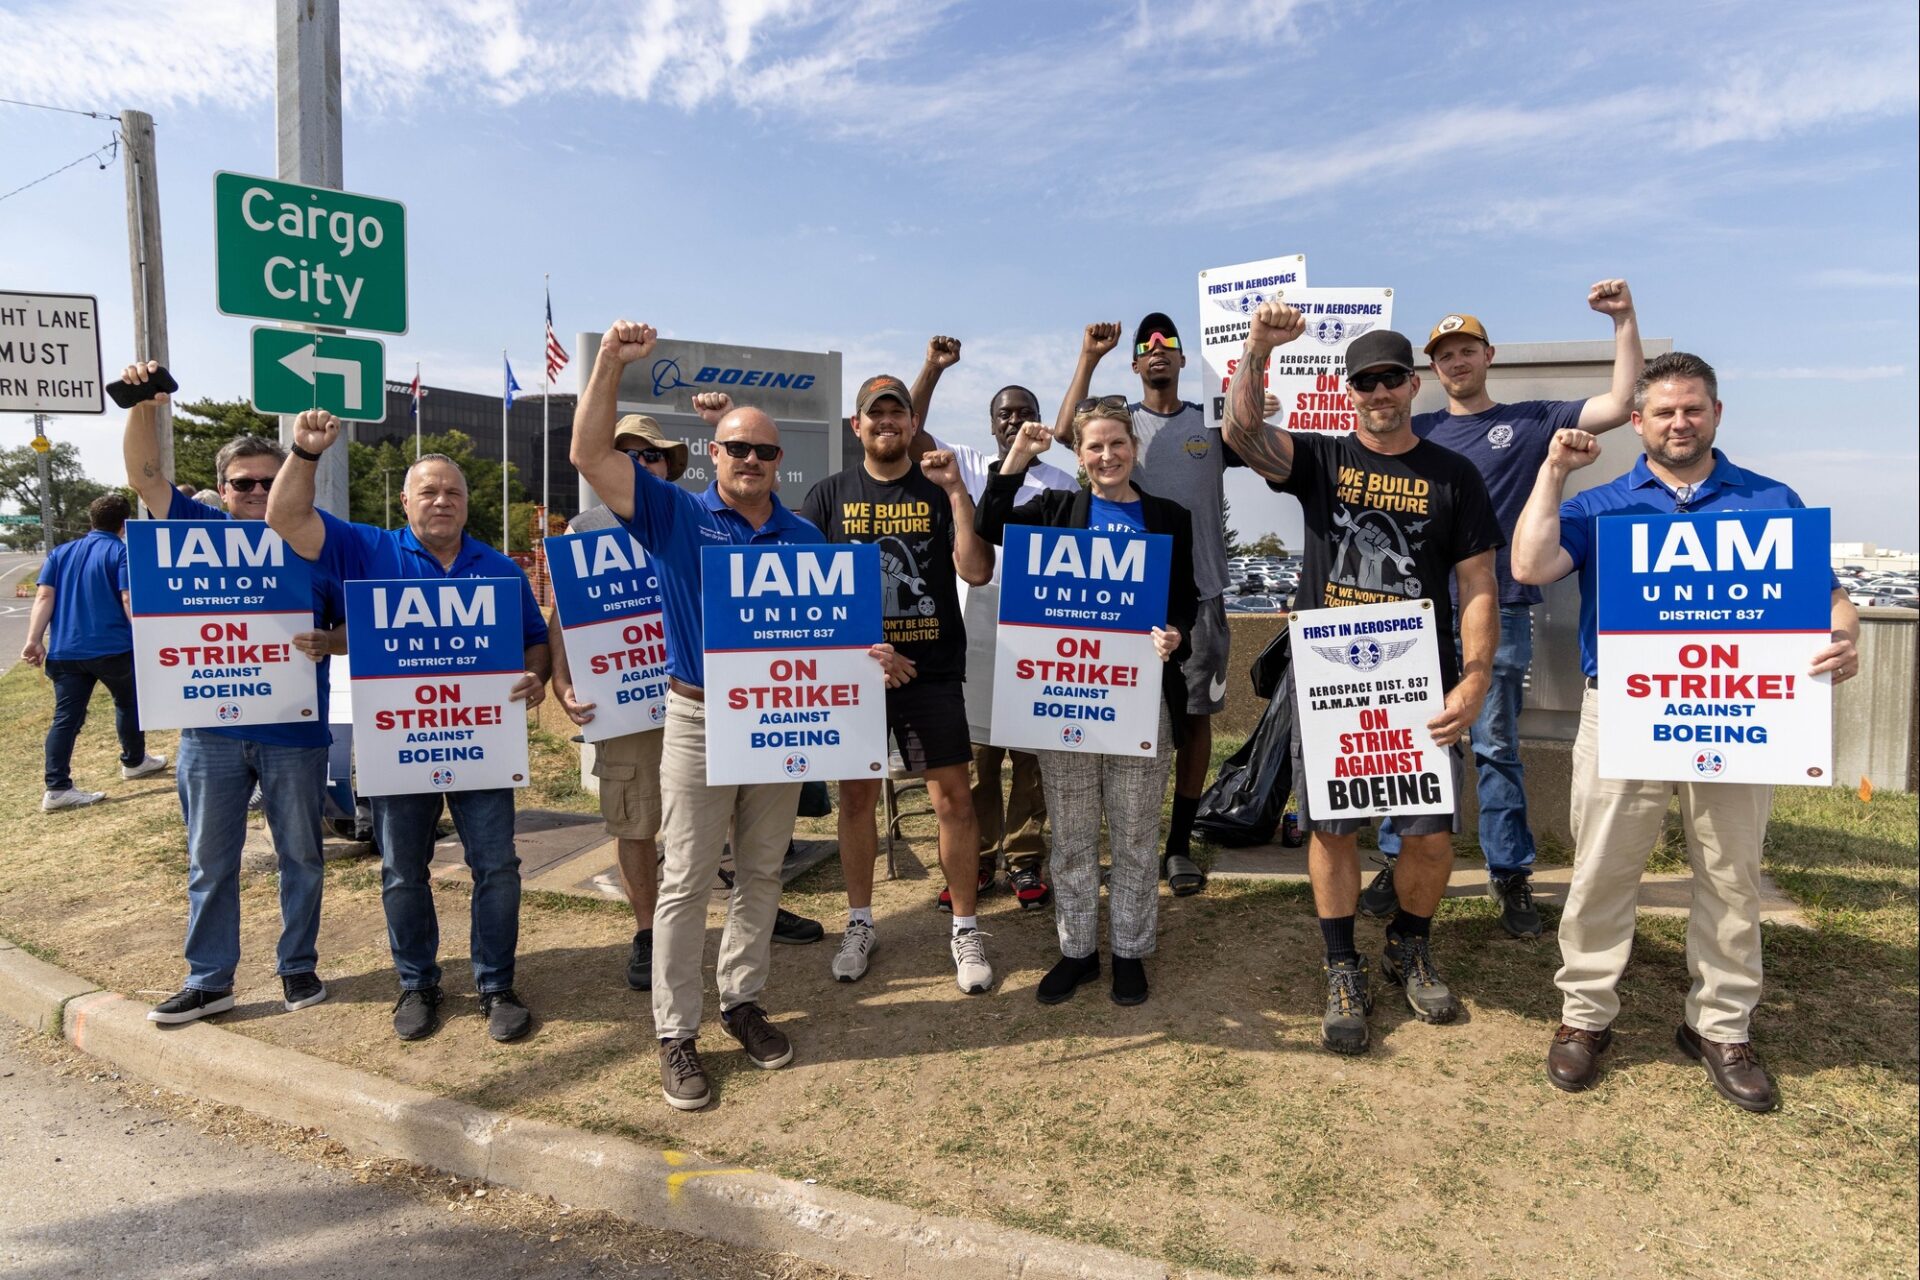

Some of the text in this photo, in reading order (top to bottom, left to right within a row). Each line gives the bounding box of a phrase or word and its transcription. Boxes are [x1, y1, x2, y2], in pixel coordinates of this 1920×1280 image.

[242, 187, 384, 257] Cargo
[264, 255, 364, 319] City
[1208, 272, 1297, 295] FIRST IN AEROSPACE
[1, 308, 91, 329] HT LANE
[1314, 303, 1324, 314] IN
[1325, 303, 1383, 315] AEROSPACE
[0, 341, 69, 365] MUST
[1280, 355, 1332, 364] AEROSPACE
[694, 366, 815, 390] BOEING
[1280, 367, 1328, 376] I.A.M.A.W
[0, 379, 94, 398] RN RIGHT
[1316, 374, 1339, 393] ON
[786, 471, 803, 483] 111
[1338, 466, 1429, 497] WE BUILD
[843, 501, 930, 518] WE BUILD
[1363, 491, 1428, 515] FUTURE
[842, 517, 930, 534] THE FUTURE
[155, 527, 284, 568] IAM
[1631, 517, 1793, 573] IAM
[1027, 532, 1147, 582] IAM
[168, 576, 277, 591] UNION
[729, 551, 855, 597] IAM
[587, 575, 658, 599] UNIO
[1033, 586, 1135, 606] UNION
[1338, 586, 1354, 599] WE
[1354, 589, 1385, 603] WON'T
[1642, 583, 1782, 602] UNION
[183, 596, 265, 605] DISTRICT 837
[372, 585, 496, 629] IAM
[603, 596, 652, 612] DISTRICT
[740, 606, 847, 623] UNION
[883, 617, 940, 630] ON'T BE USED
[1045, 608, 1121, 621] DISTRICT 837
[1659, 609, 1765, 621] DISTRICT 837
[200, 622, 248, 642] ON
[622, 621, 664, 645] ON
[753, 628, 835, 640] DISTRICT 837
[890, 629, 940, 642] INJUSTICE
[1303, 616, 1424, 640] FIRST IN AEROSPACE
[384, 636, 489, 652] UNION
[1056, 637, 1101, 660] ON
[159, 644, 290, 667] STRIKE!
[398, 656, 477, 667] DISTRICT 837
[590, 645, 664, 675] STRI
[1678, 644, 1739, 669] ON
[191, 666, 262, 679] AGAINST
[621, 665, 668, 684] AGAIN
[769, 659, 817, 682] ON
[1016, 659, 1138, 687] STRIKE!
[183, 682, 272, 699] BOEING
[415, 683, 461, 705] ON
[616, 681, 669, 705] BOEI
[728, 684, 859, 710] STRIKE!
[1042, 685, 1109, 699] AGAINST
[1309, 676, 1429, 698] AEROSPACE DIST. 837
[1626, 673, 1795, 700] STRIKE!
[1311, 690, 1428, 711] I.A.M.A.W AFL-CIO
[1664, 703, 1755, 717] AGAINST
[375, 705, 502, 730] STRIKE!
[759, 711, 830, 725] AGAINST
[1033, 701, 1116, 722] BOEING
[1359, 708, 1389, 731] ON
[406, 730, 474, 743] AGAINST
[751, 729, 840, 748] BOEING
[1339, 728, 1414, 755] STRIKE
[1653, 724, 1768, 744] BOEING
[398, 746, 484, 763] BOEING
[1335, 750, 1424, 778] AGAINST
[1327, 772, 1442, 811] BOEING
